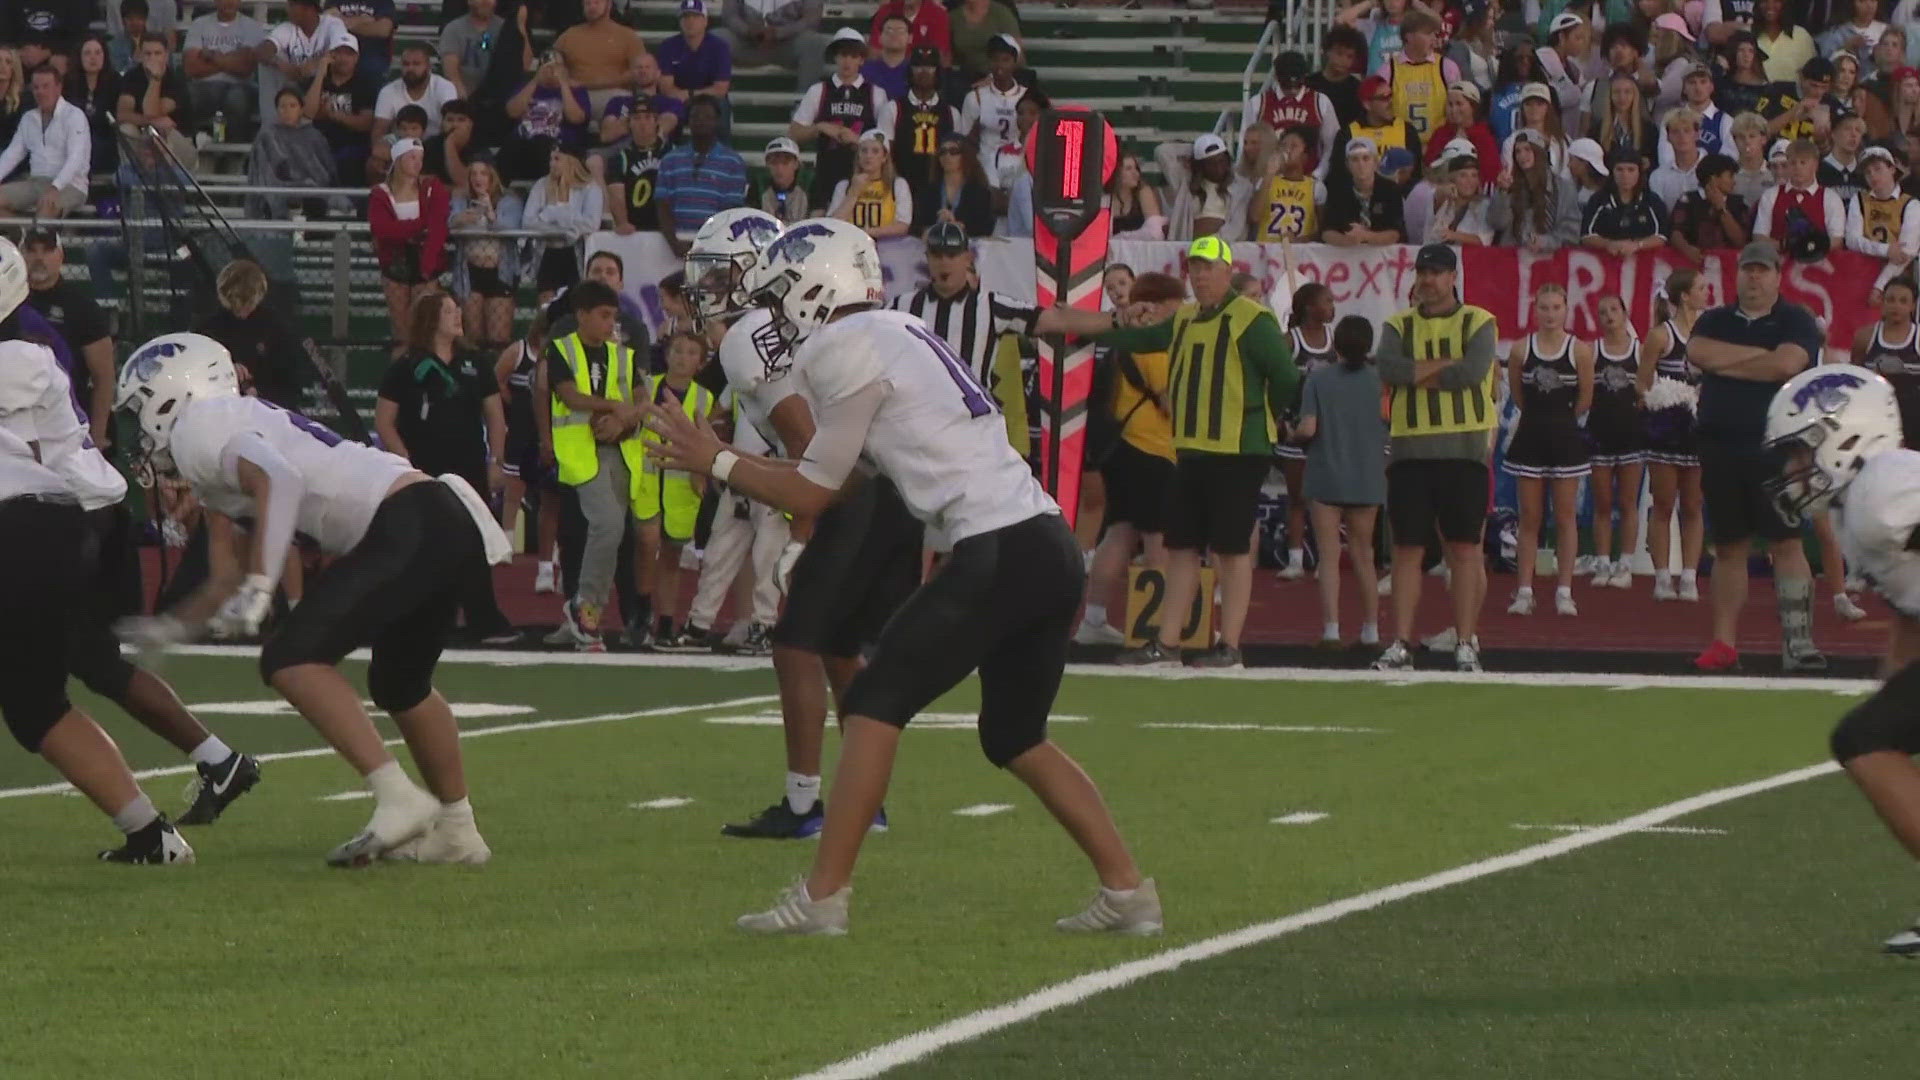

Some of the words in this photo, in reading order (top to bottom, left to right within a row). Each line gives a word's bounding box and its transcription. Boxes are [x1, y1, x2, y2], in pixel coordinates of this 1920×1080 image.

[1273, 107, 1308, 123] JAMES
[1408, 103, 1427, 133] 5
[914, 127, 938, 154] 11
[998, 118, 1010, 141] 2
[1056, 119, 1083, 199] 1
[1276, 187, 1306, 200] JAMES
[853, 202, 882, 228] 00
[1266, 202, 1306, 237] 23
[1298, 247, 1414, 302] next
[1516, 248, 1836, 332] FRIAS
